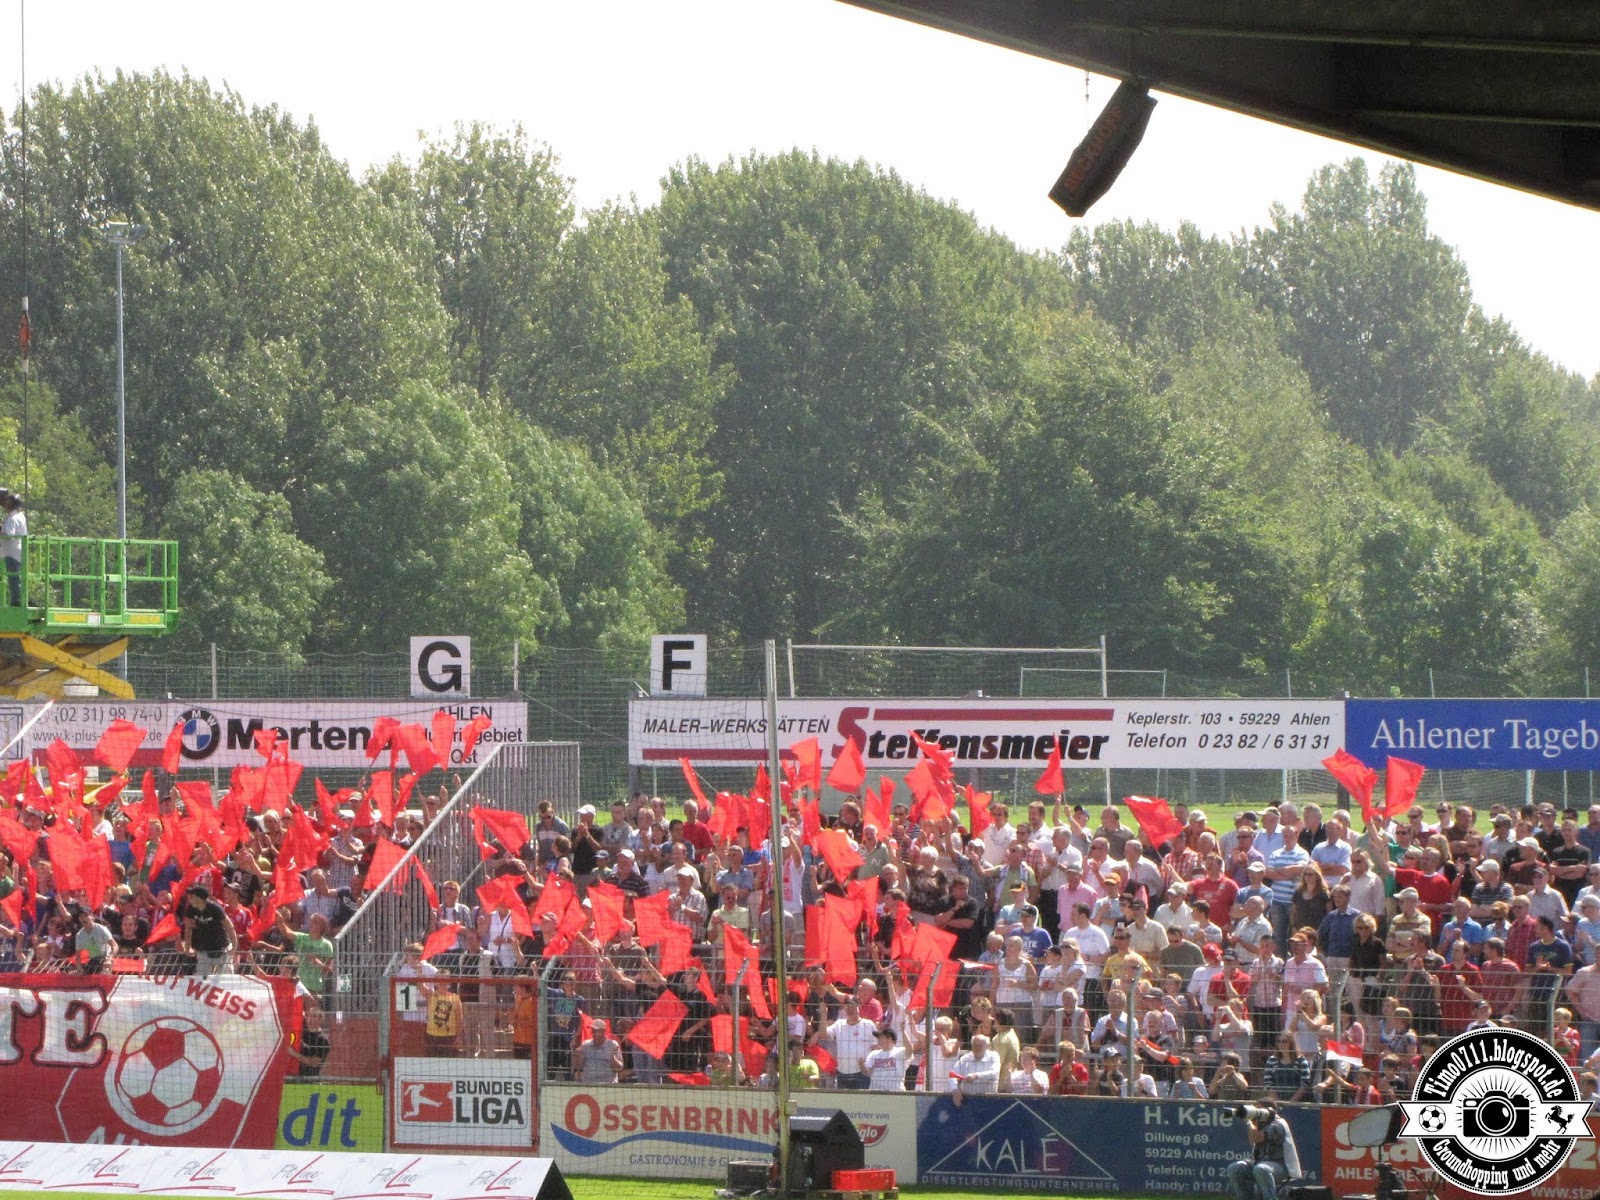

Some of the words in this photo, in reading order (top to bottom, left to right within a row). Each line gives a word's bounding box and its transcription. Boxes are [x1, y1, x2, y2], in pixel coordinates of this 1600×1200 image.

[418, 641, 462, 693] G
[662, 640, 695, 691] F
[82, 707, 104, 722] 31)
[1127, 712, 1192, 727] Keplerstr.
[1200, 713, 1221, 725] 103
[1239, 713, 1281, 725] 59229
[1290, 713, 1331, 726] Ahlen
[643, 715, 830, 733] MALER-WERKSÄTTEN
[227, 718, 392, 751] Merten
[1127, 732, 1187, 748] Telefon
[1198, 733, 1209, 749] 0
[1212, 733, 1233, 749] 23
[1238, 733, 1259, 749] 82
[1274, 734, 1284, 749] 6
[1288, 734, 1307, 749] 31
[1311, 734, 1331, 750] 31
[1370, 718, 1496, 750] Ahlener
[1503, 718, 1600, 759] Tageb
[186, 978, 257, 1021] WEISS
[399, 985, 410, 1010] 1
[455, 1080, 524, 1096] BUNDES
[455, 1096, 525, 1125] LIGA
[846, 1111, 873, 1119] artner
[1144, 1105, 1169, 1125] H.
[282, 1092, 362, 1148] dit
[856, 1126, 878, 1142] glo
[1144, 1131, 1191, 1145] Dillweg
[1194, 1133, 1209, 1144] 69
[629, 1153, 705, 1167] GASTRONOMIE
[976, 1131, 1061, 1174] KALÉ
[1145, 1148, 1182, 1159] 59229
[1184, 1150, 1253, 1161] Ahlen-Dolb
[1147, 1163, 1196, 1177] Telefon:
[921, 1174, 1121, 1191] DIENSTLEISTUNGSUNTERNEHMEN
